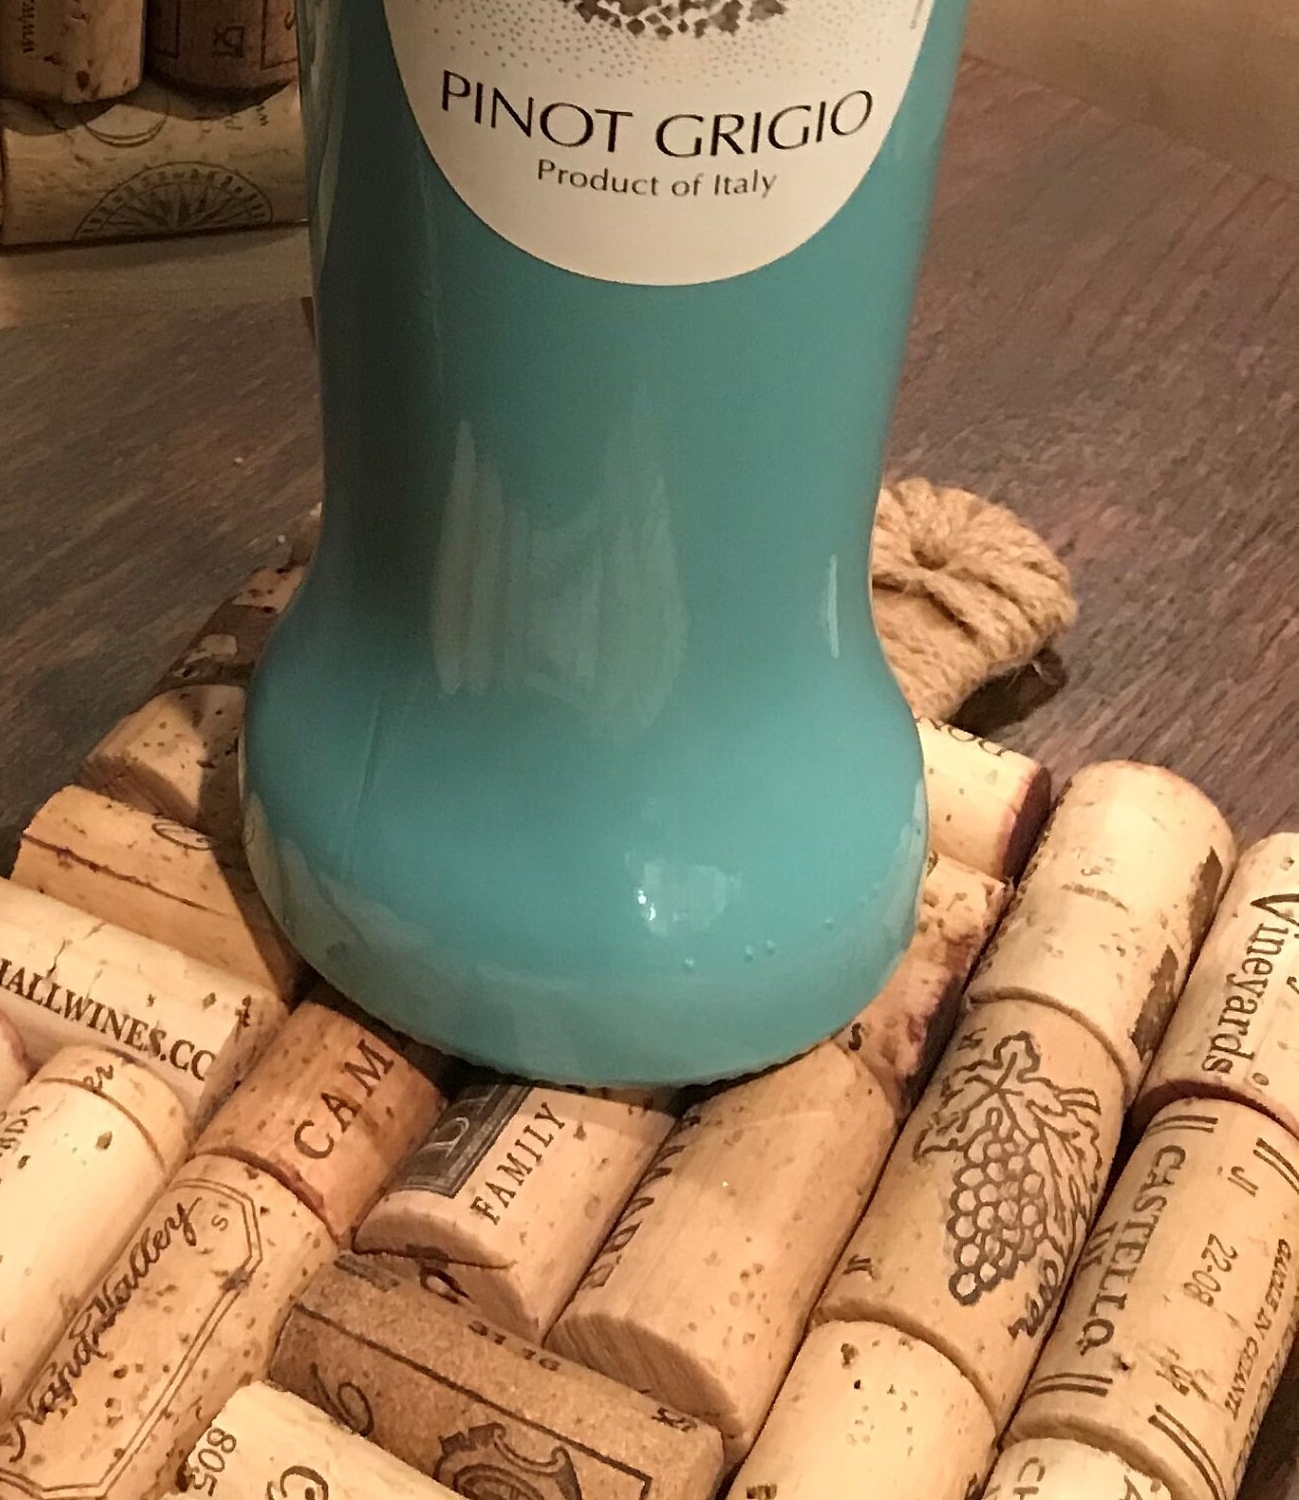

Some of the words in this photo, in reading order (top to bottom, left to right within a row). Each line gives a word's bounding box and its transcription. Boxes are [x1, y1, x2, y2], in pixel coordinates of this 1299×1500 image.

[441, 69, 634, 153] PINOT
[654, 90, 875, 158] GRIGIO
[537, 159, 661, 198] Product
[671, 173, 704, 197] of
[714, 169, 778, 199] Italy
[470, 1101, 566, 1226] FAMILY
[1075, 1144, 1186, 1357] CASTELLO
[1183, 1233, 1239, 1308] 22-08
